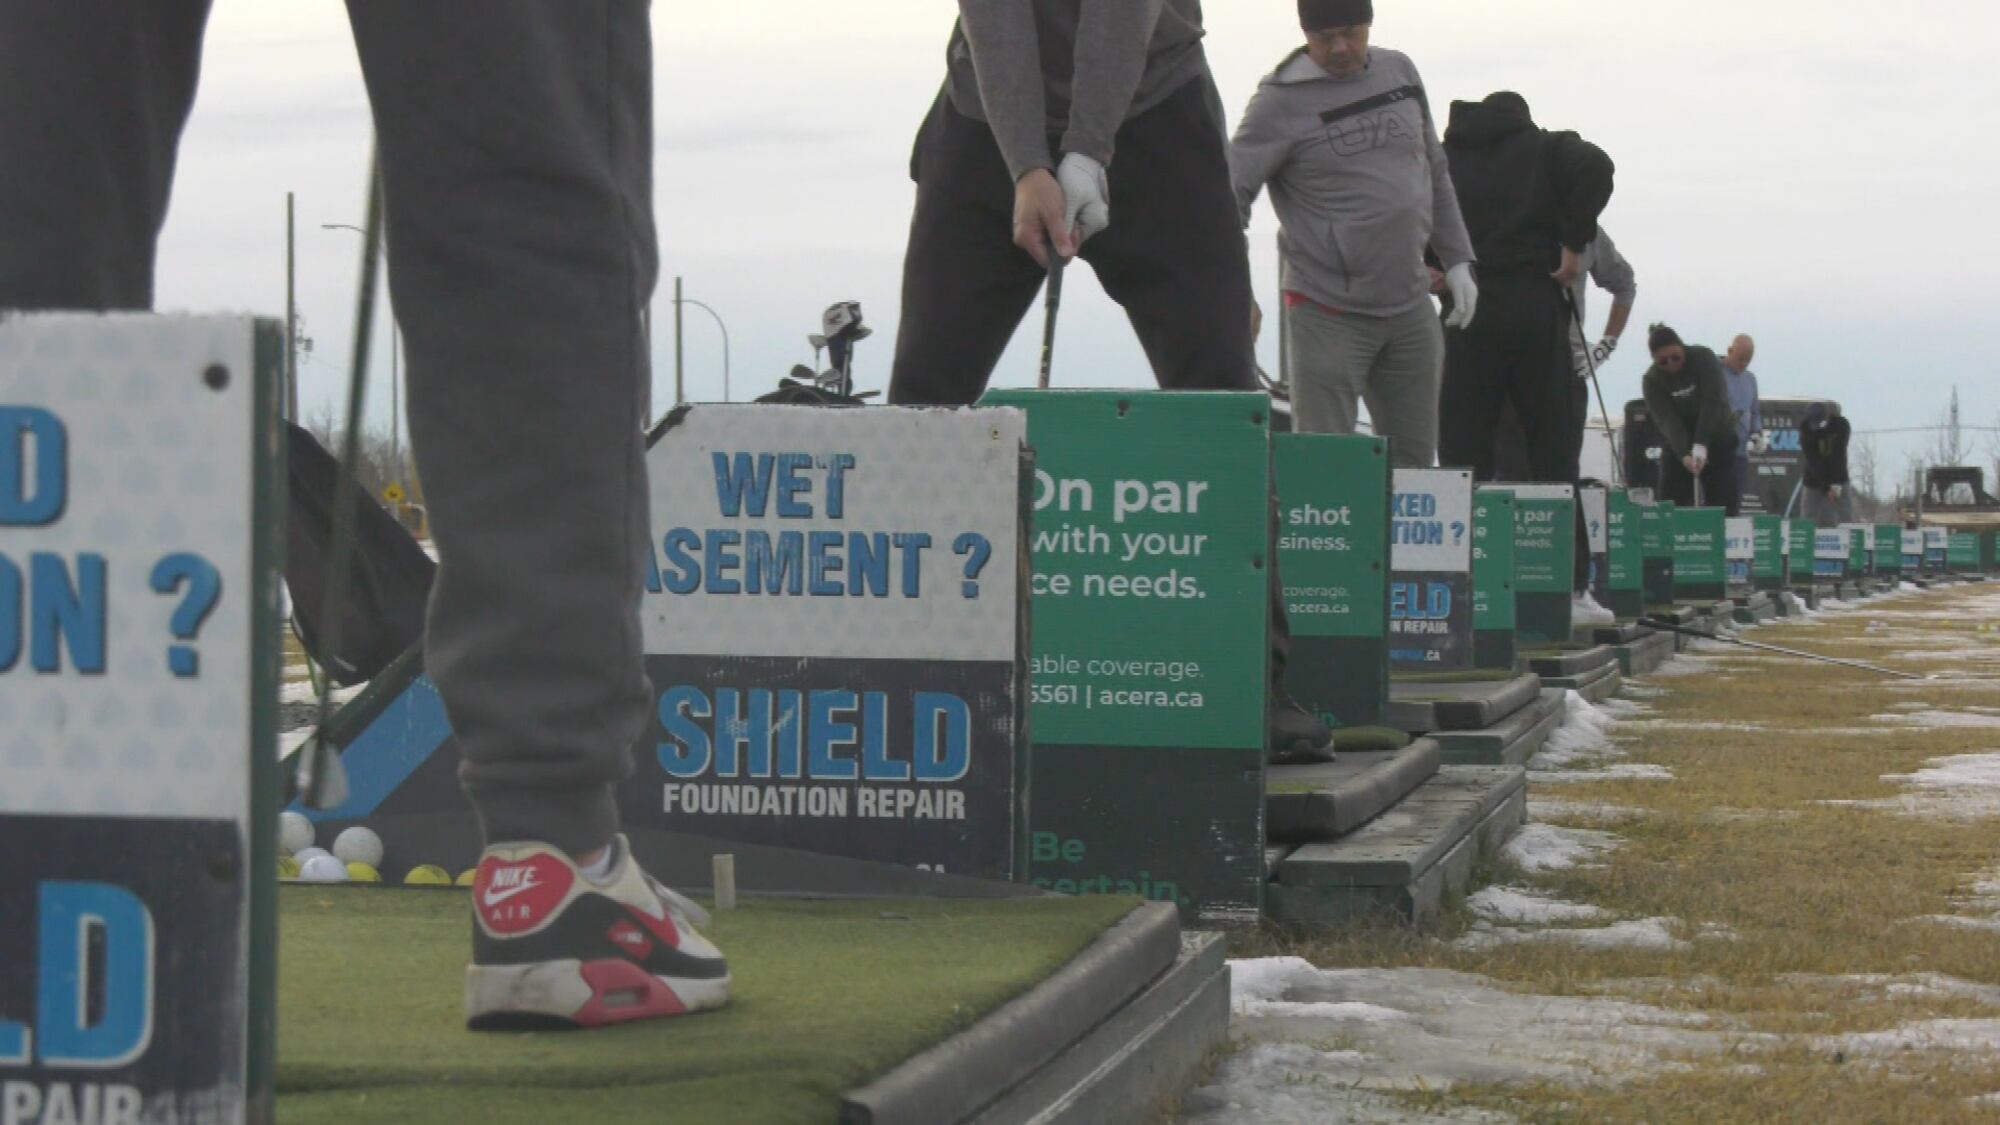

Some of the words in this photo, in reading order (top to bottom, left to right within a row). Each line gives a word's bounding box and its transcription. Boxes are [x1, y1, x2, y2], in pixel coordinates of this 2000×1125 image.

[711, 451, 855, 519] WET
[1114, 479, 1209, 523] par
[1289, 503, 1351, 526] shot
[1524, 510, 1554, 525] par
[1120, 531, 1208, 561] your
[1083, 568, 1206, 598] needs.
[1289, 603, 1350, 614] acera.ca
[1404, 621, 1449, 634] REPAIR
[1087, 658, 1204, 682] coverage.
[1099, 689, 1204, 707] acera.ca
[656, 685, 971, 781] SHIELD
[663, 783, 848, 817] FOUNDATION
[857, 786, 966, 819] REPAIR
[1032, 831, 1086, 863] Be
[491, 866, 539, 888] NIKE
[492, 904, 530, 920] AIR
